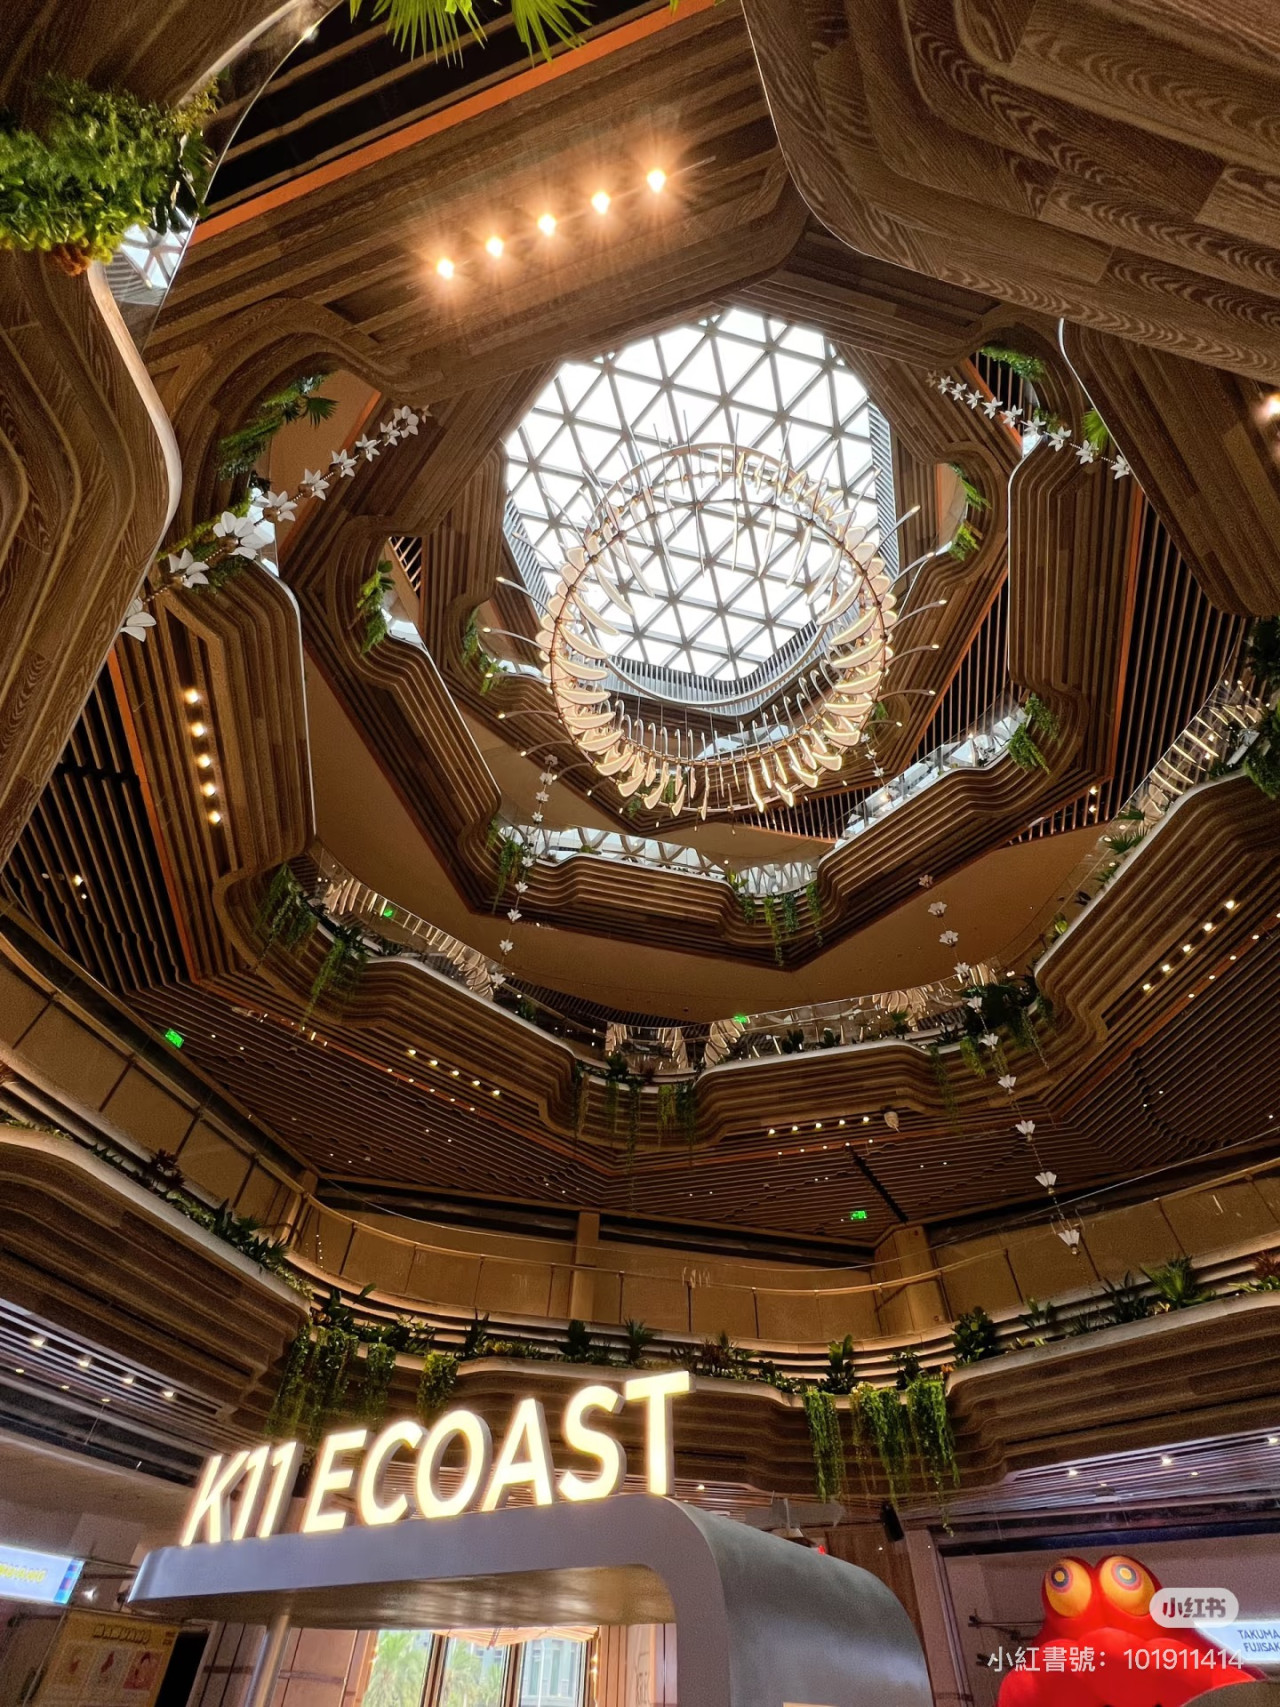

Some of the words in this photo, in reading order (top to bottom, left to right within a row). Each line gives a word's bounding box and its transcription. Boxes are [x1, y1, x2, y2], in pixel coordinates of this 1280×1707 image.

[180, 1441, 299, 1548] K11
[302, 1370, 692, 1534] ECOAST
[1237, 1629, 1280, 1640] TAKUMA
